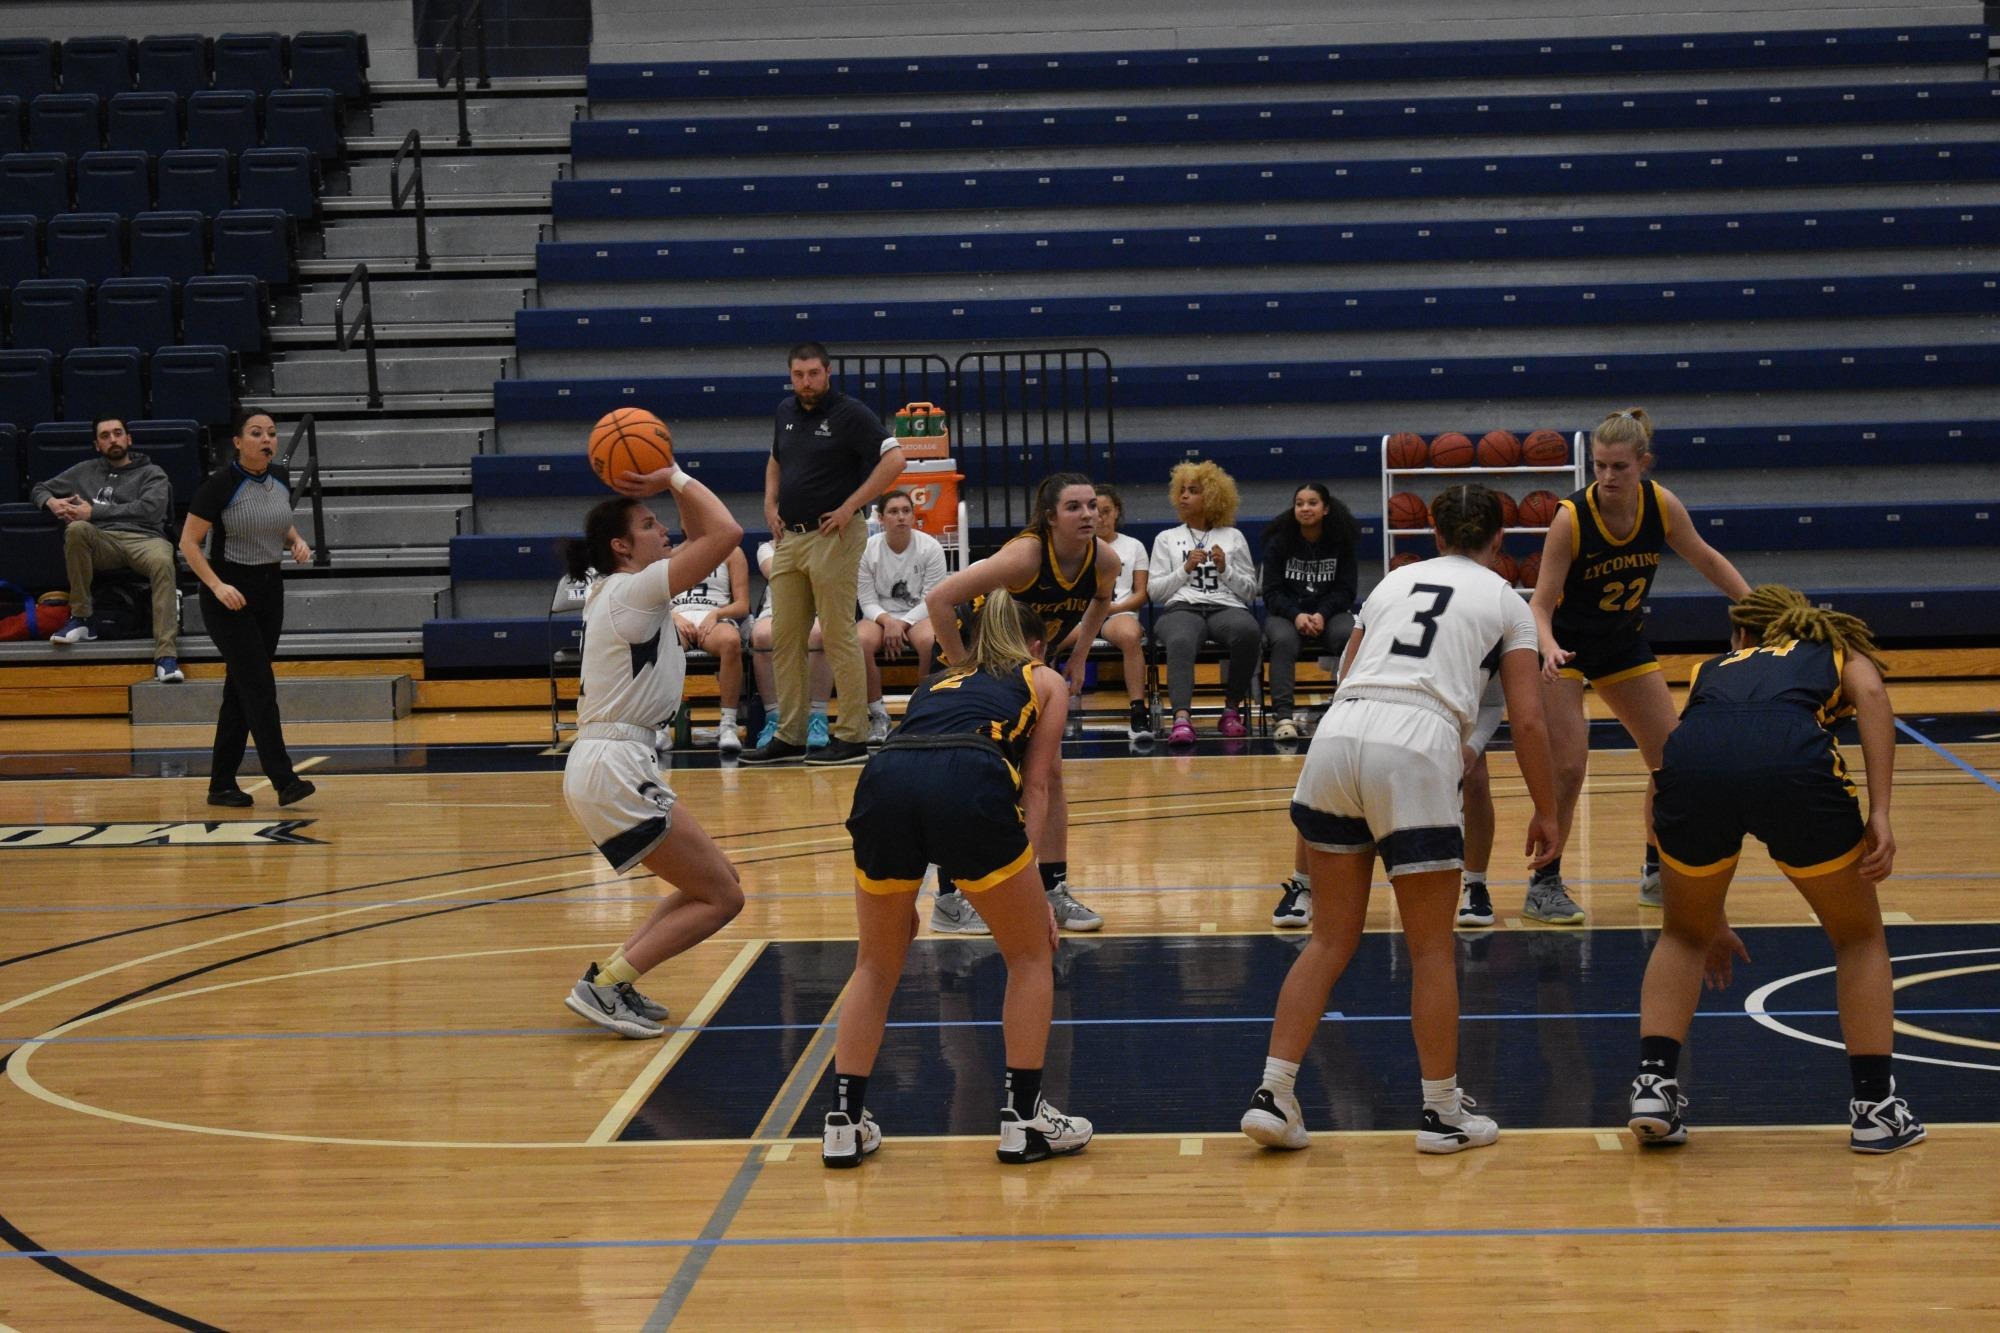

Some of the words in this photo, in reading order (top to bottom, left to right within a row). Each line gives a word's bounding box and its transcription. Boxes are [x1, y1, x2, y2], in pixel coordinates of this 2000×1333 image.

[914, 419, 925, 430] G
[910, 488, 926, 505] G
[1190, 566, 1219, 589] 35
[1583, 553, 1661, 581] LYCOMING
[1599, 577, 1648, 611] 22
[1388, 582, 1455, 659] 3
